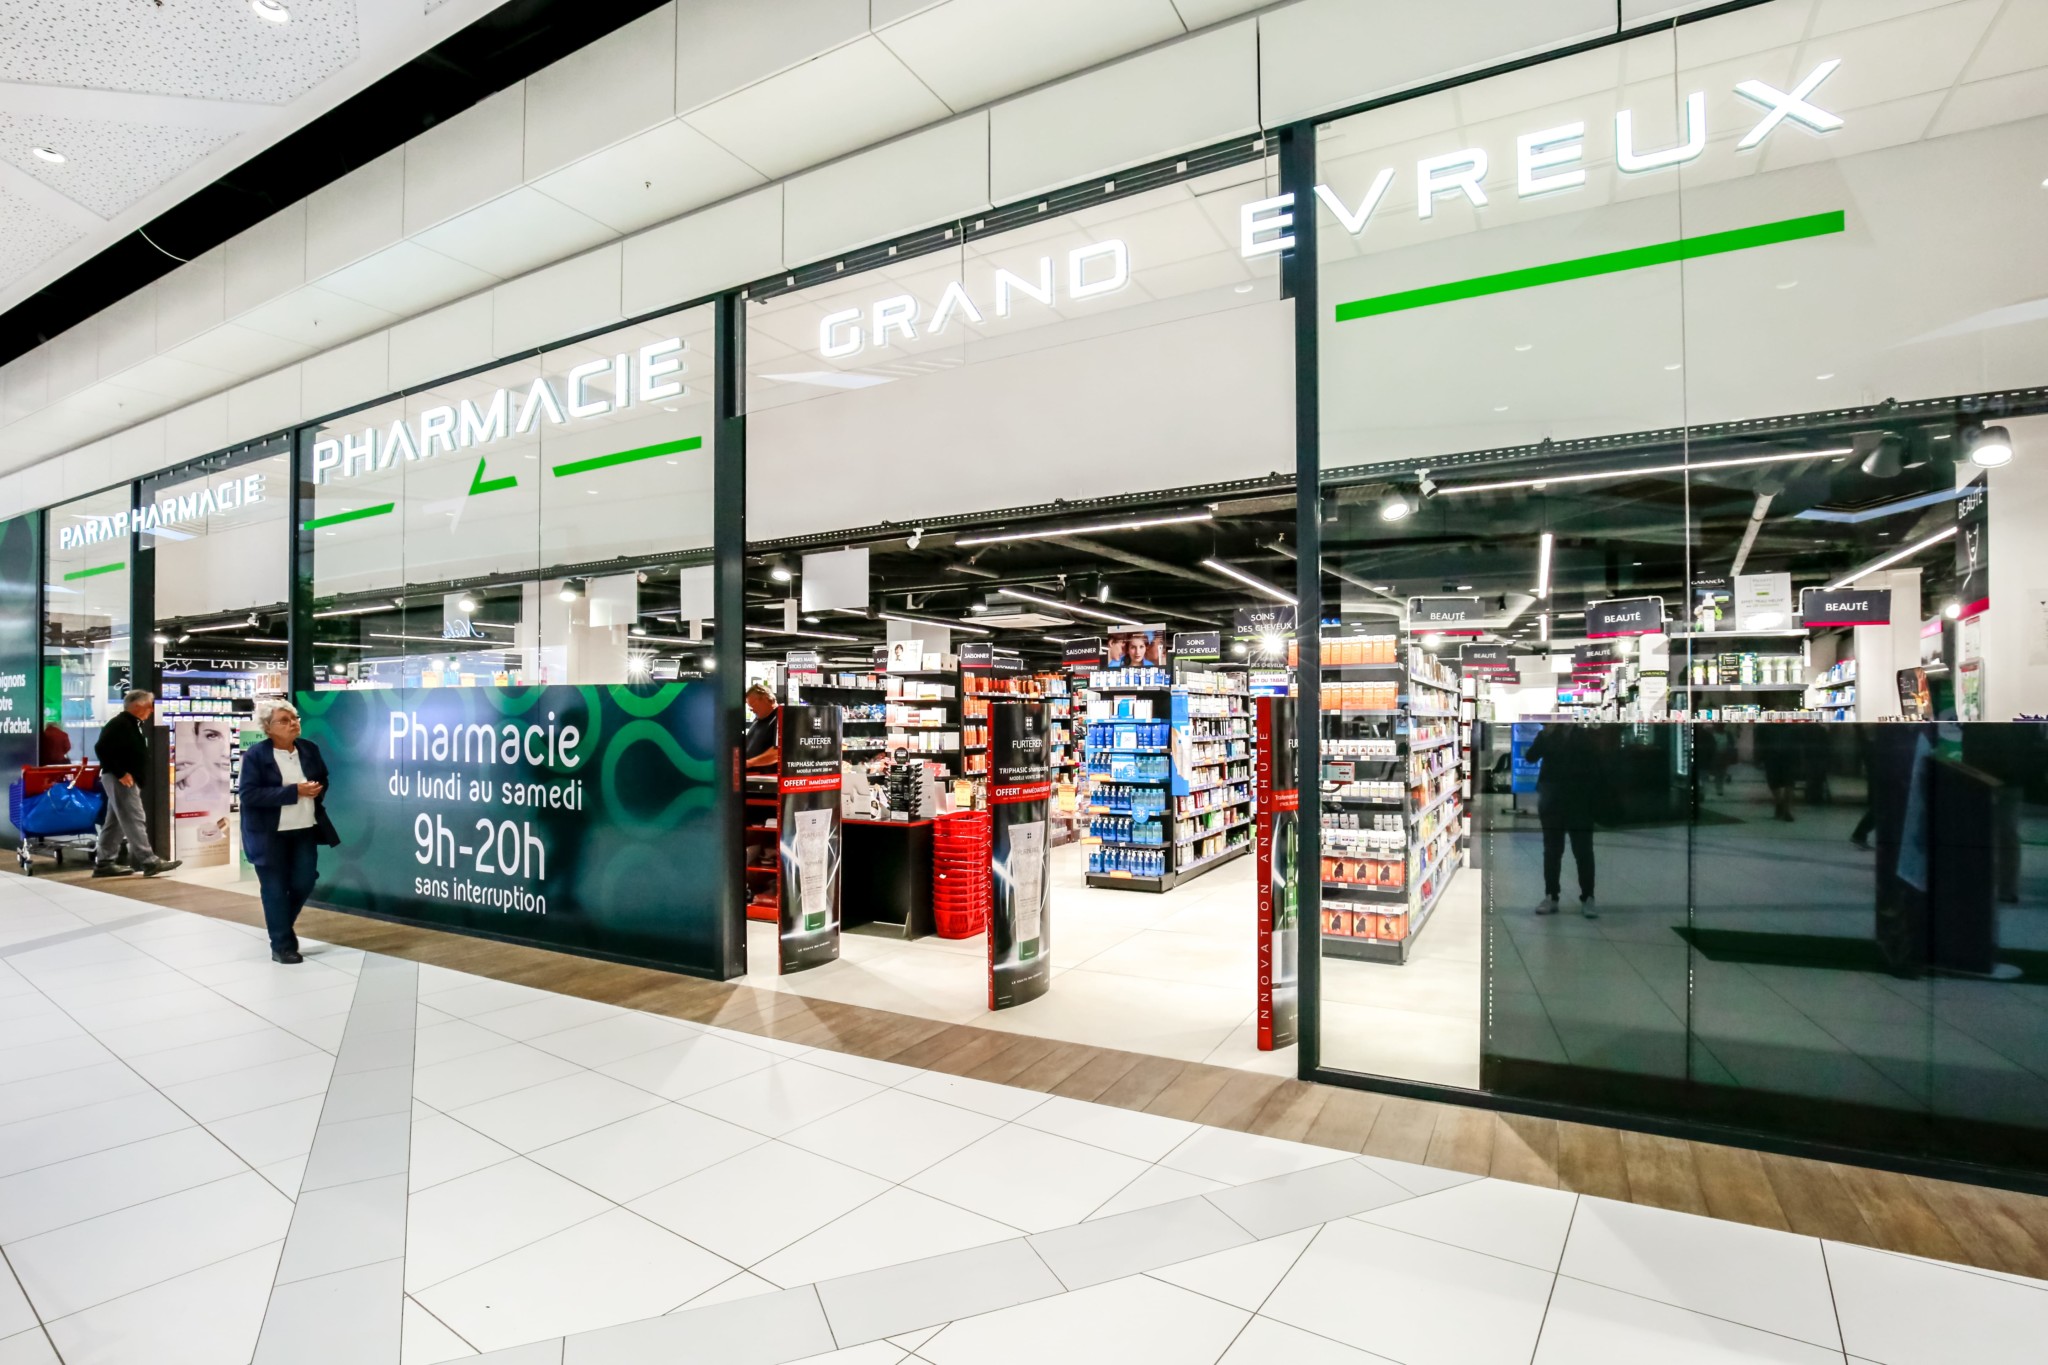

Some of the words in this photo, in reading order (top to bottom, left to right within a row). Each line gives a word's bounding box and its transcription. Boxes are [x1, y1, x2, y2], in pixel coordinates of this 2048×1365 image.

[313, 337, 686, 484] PHARMACIE
[819, 238, 1128, 358] GRAND
[1240, 58, 1845, 258] EVREUX
[1958, 482, 1983, 520] BEAUTÉ
[60, 473, 265, 550] PARAPHARMACIE
[1825, 601, 1869, 611] BEAUTÉ
[1250, 612, 1276, 622] SOINS
[1430, 611, 1466, 621] BEAUTÉ
[1604, 611, 1641, 623] BEAUTÉ
[1237, 625, 1253, 633] DES
[1254, 622, 1293, 633] CHEVEUX
[1066, 648, 1097, 656] SAISONNIER
[1586, 649, 1611, 657] BEAUTÉ
[389, 711, 581, 768] Pharmacie
[800, 737, 832, 746] FURTERER
[1012, 739, 1043, 749] FURTERER
[999, 766, 1028, 775] TRIPHASIC
[783, 779, 807, 788] OFFERT
[389, 769, 410, 797] du
[417, 771, 461, 801] lundi
[469, 780, 493, 803] au
[501, 779, 583, 811] samedi
[995, 787, 1021, 797] OFFERT
[1259, 733, 1269, 863] ANTICHUTE
[414, 813, 546, 881] 9h-20h
[415, 877, 449, 899] sans
[453, 877, 547, 915] interruption
[1260, 883, 1270, 1031] INNOVATION
